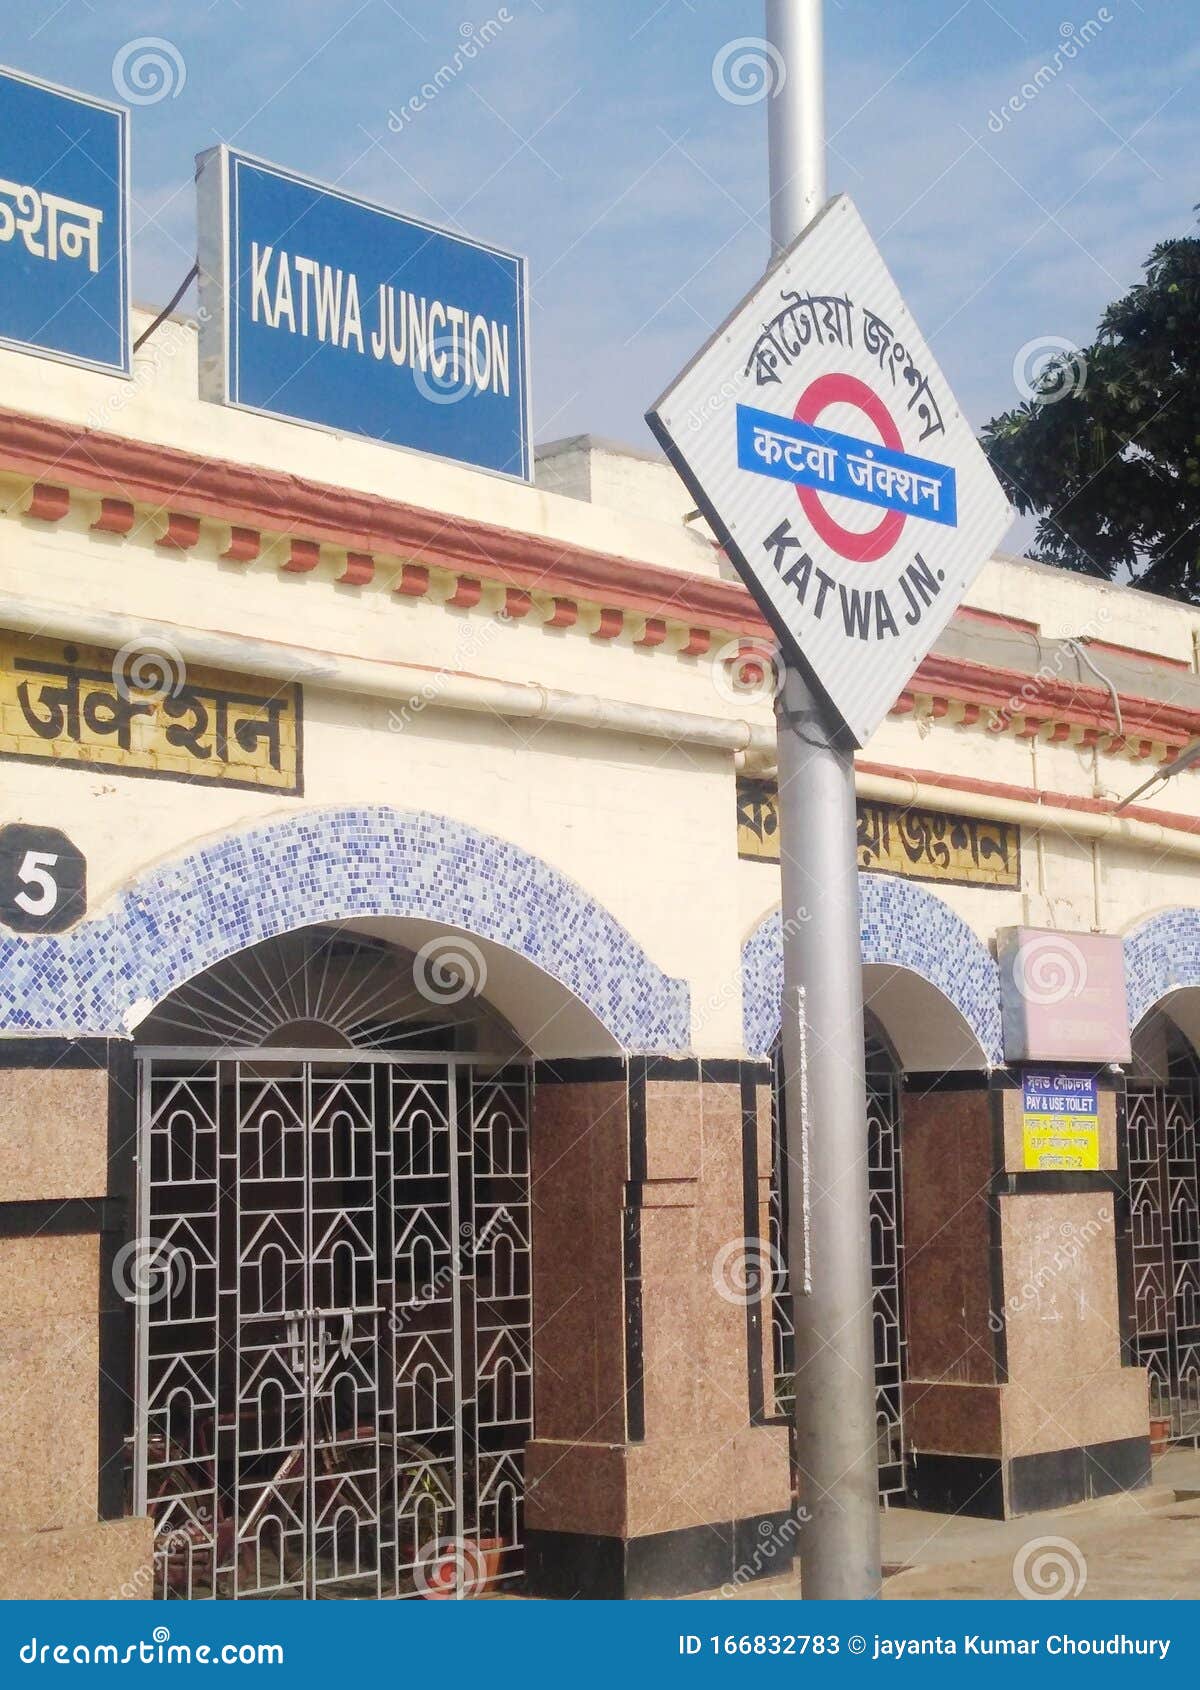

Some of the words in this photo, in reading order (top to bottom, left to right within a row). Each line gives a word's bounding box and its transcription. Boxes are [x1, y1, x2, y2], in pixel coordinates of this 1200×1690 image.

[251, 241, 365, 354] KATWA
[371, 283, 510, 398] JUNCTION
[744, 290, 854, 387] কাটোয়া
[862, 308, 946, 443] জংশন
[753, 426, 839, 482] कटवा
[846, 449, 943, 512] जंक्शन
[762, 517, 900, 641] KATWA
[897, 551, 946, 627] JN.
[14, 852, 59, 917] 5
[1026, 1095, 1041, 1110] PAY
[1041, 1096, 1048, 1110] &
[1048, 1096, 1065, 1111] USE
[1066, 1097, 1094, 1112] TOILET
